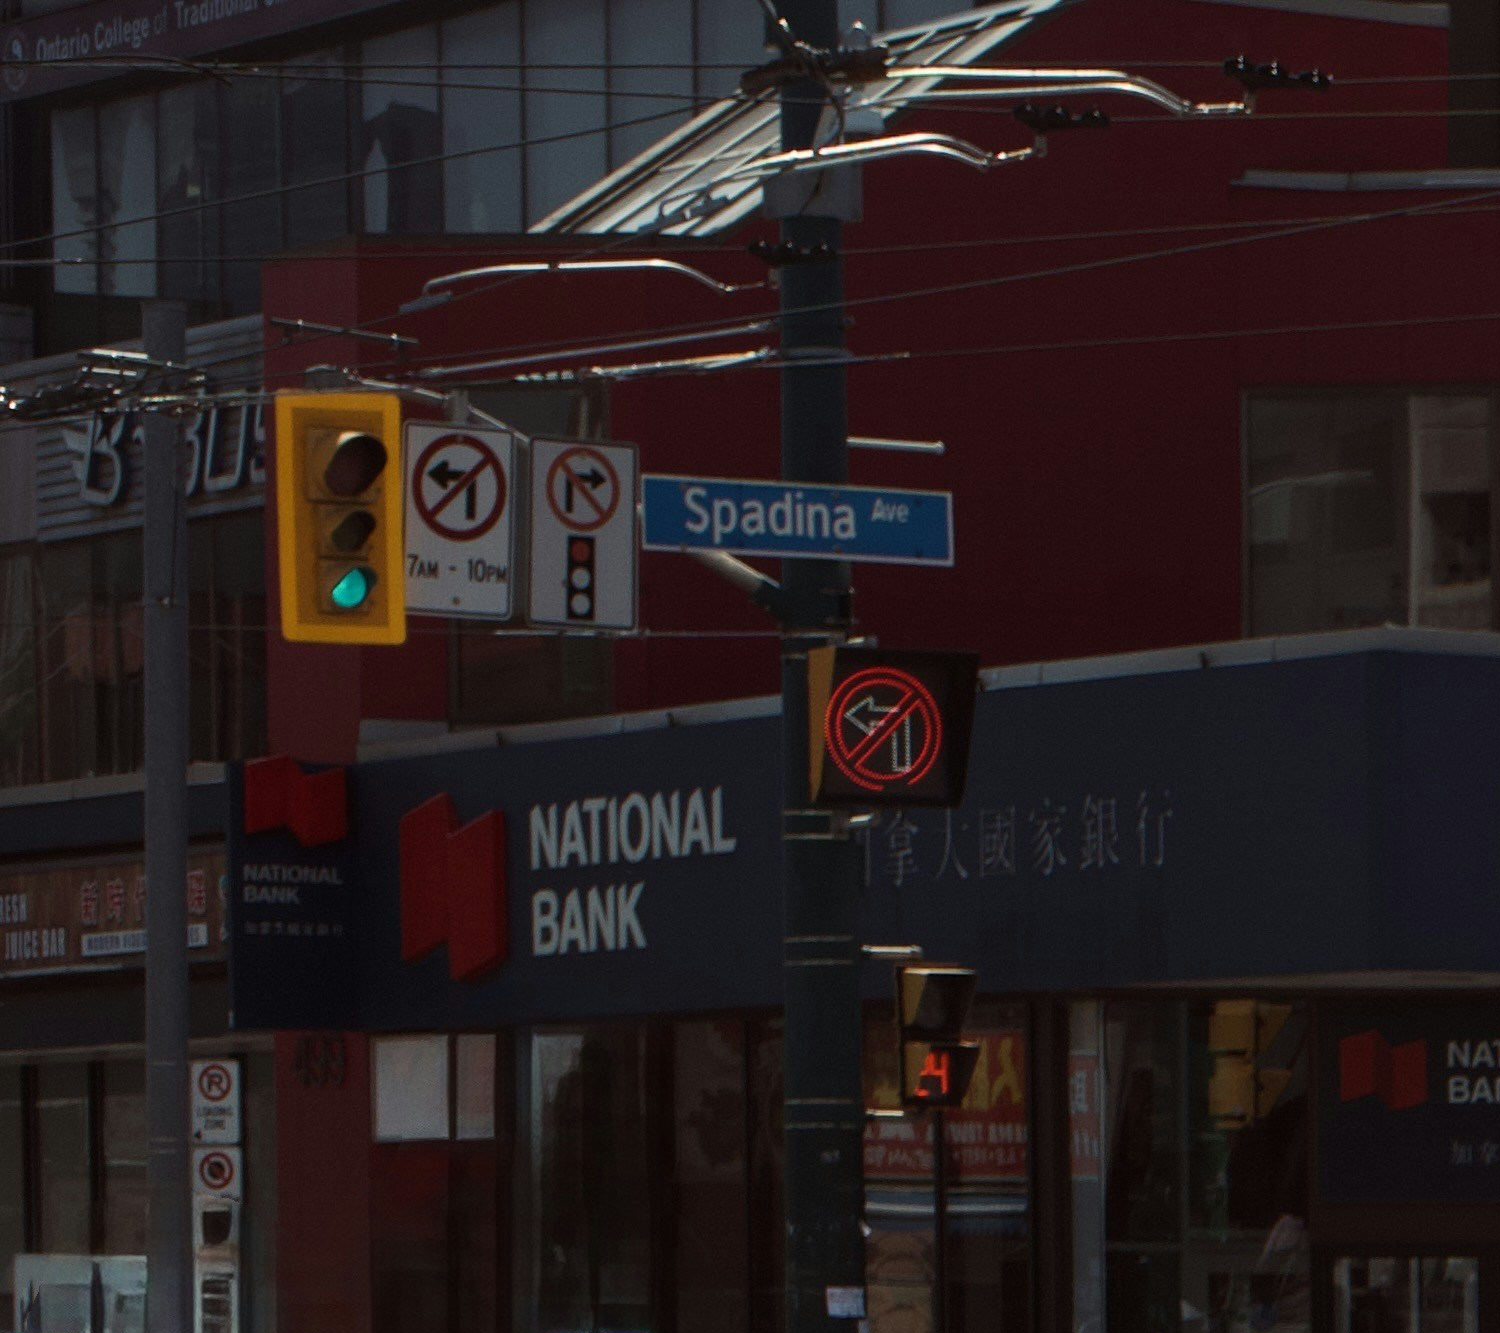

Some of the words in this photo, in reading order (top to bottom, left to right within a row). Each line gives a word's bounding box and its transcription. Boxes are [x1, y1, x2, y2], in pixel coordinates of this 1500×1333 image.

[36, 27, 90, 61] Ontario
[94, 16, 150, 48] College
[153, 7, 168, 35] of
[684, 486, 856, 544] Spadina
[870, 497, 910, 523] Ave
[468, 558, 507, 582] 10PM
[529, 784, 737, 871] NATIONAL
[243, 864, 343, 885] NATIONAL
[243, 884, 300, 904] BANK
[531, 880, 648, 957] BANK
[42, 927, 66, 957] BAR
